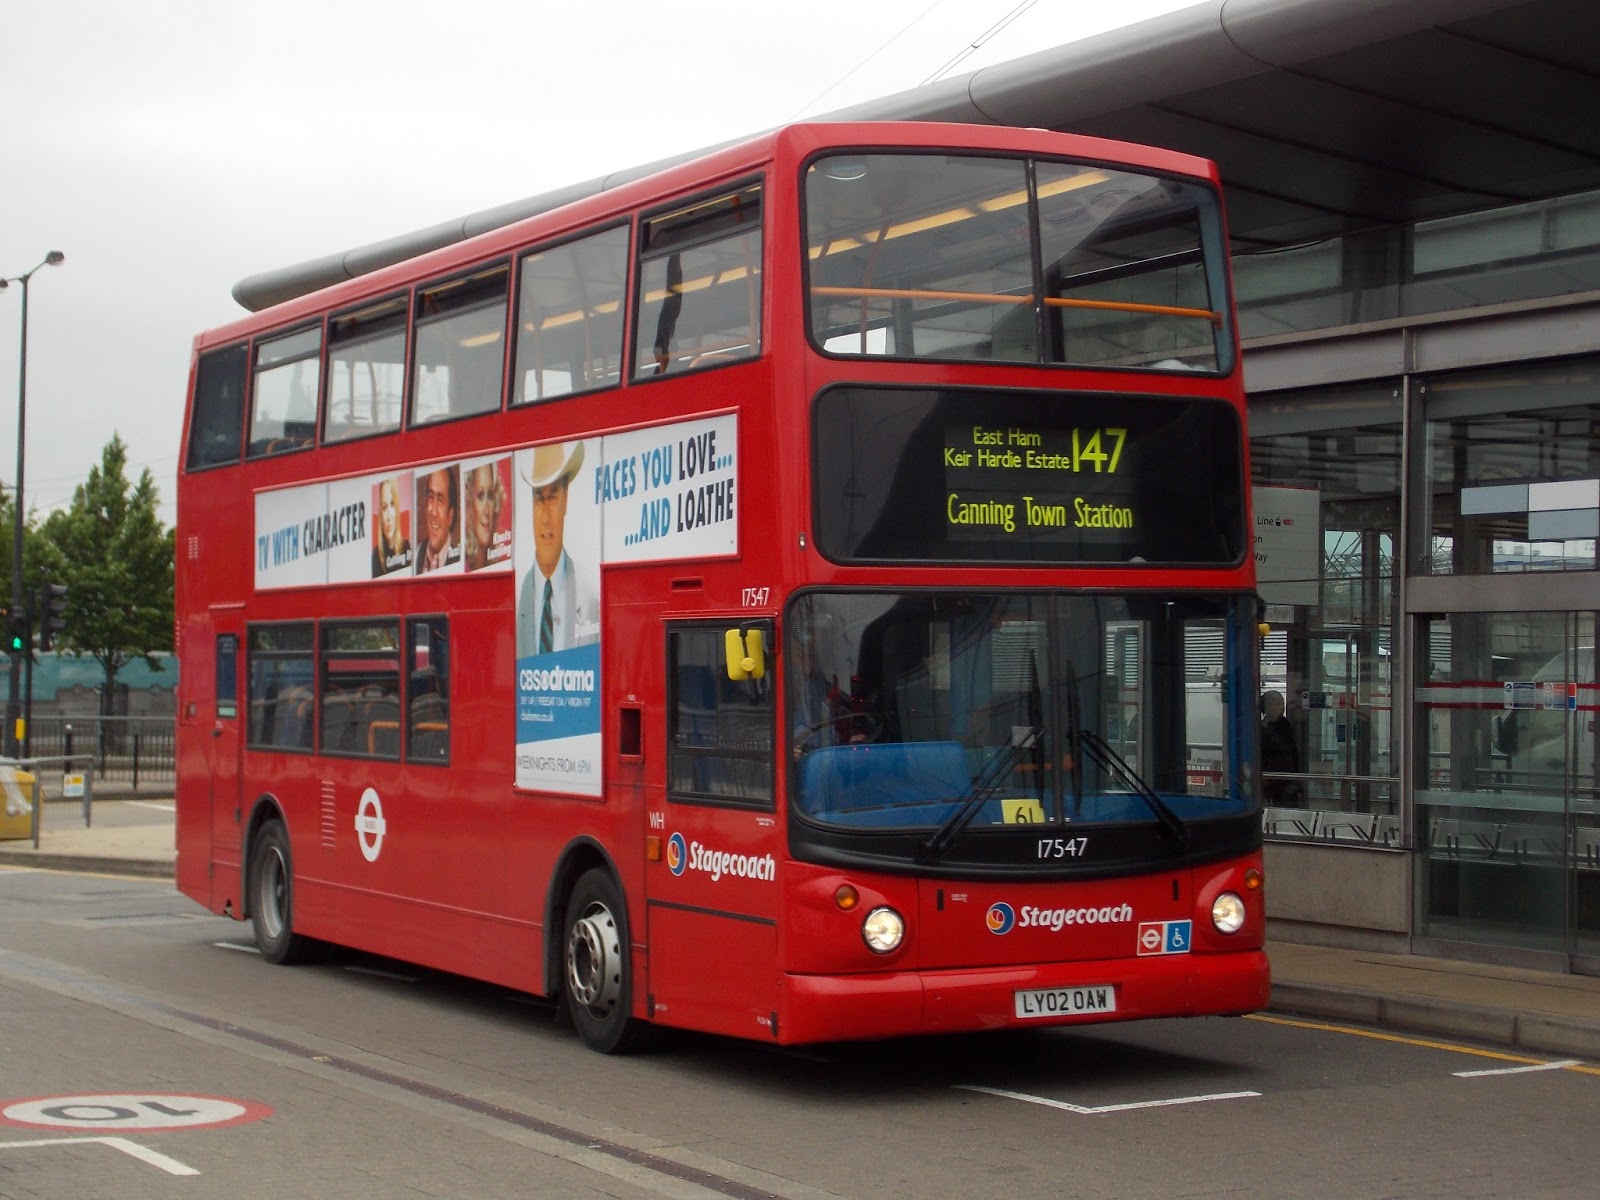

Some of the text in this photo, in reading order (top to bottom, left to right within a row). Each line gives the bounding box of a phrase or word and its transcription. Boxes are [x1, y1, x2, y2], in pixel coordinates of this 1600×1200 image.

[973, 426, 1041, 447] East Ham
[944, 447, 1070, 469] Keir Hardie Estate
[1072, 427, 1127, 473] 147
[595, 430, 732, 505] FACES YOU LOVE...
[624, 478, 734, 547] ...AND LOATHE
[947, 493, 1133, 533] Canning Town Station
[1257, 516, 1274, 526] Line
[258, 501, 365, 572] TV WITH CHARACTER
[742, 587, 770, 606] 17547
[556, 757, 576, 774] FROM
[649, 812, 665, 829] WH
[1015, 807, 1034, 824] 61
[1038, 838, 1088, 858] 17547
[688, 841, 776, 881] Stagecoach
[1018, 903, 1133, 932] Stagecoach
[1023, 992, 1069, 1013] LY02
